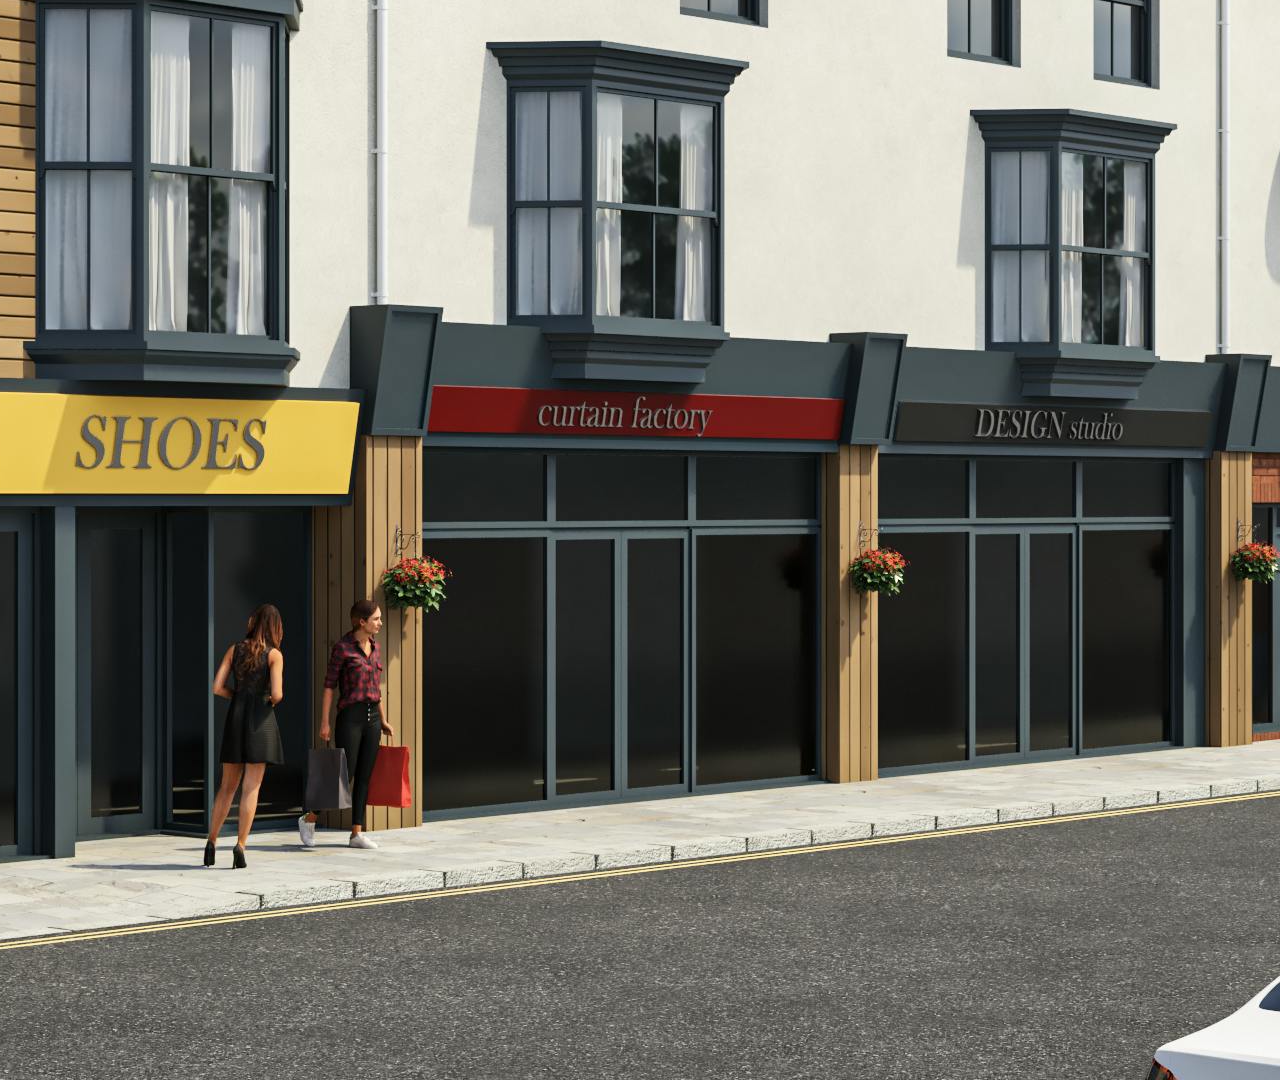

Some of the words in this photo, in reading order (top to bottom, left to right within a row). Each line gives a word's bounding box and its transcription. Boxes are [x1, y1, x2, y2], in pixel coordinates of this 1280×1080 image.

[538, 401, 624, 429] curtain
[631, 396, 713, 437] factory
[975, 408, 1066, 439] DESIGN
[1069, 412, 1124, 440] studio
[74, 414, 267, 470] SHOES
